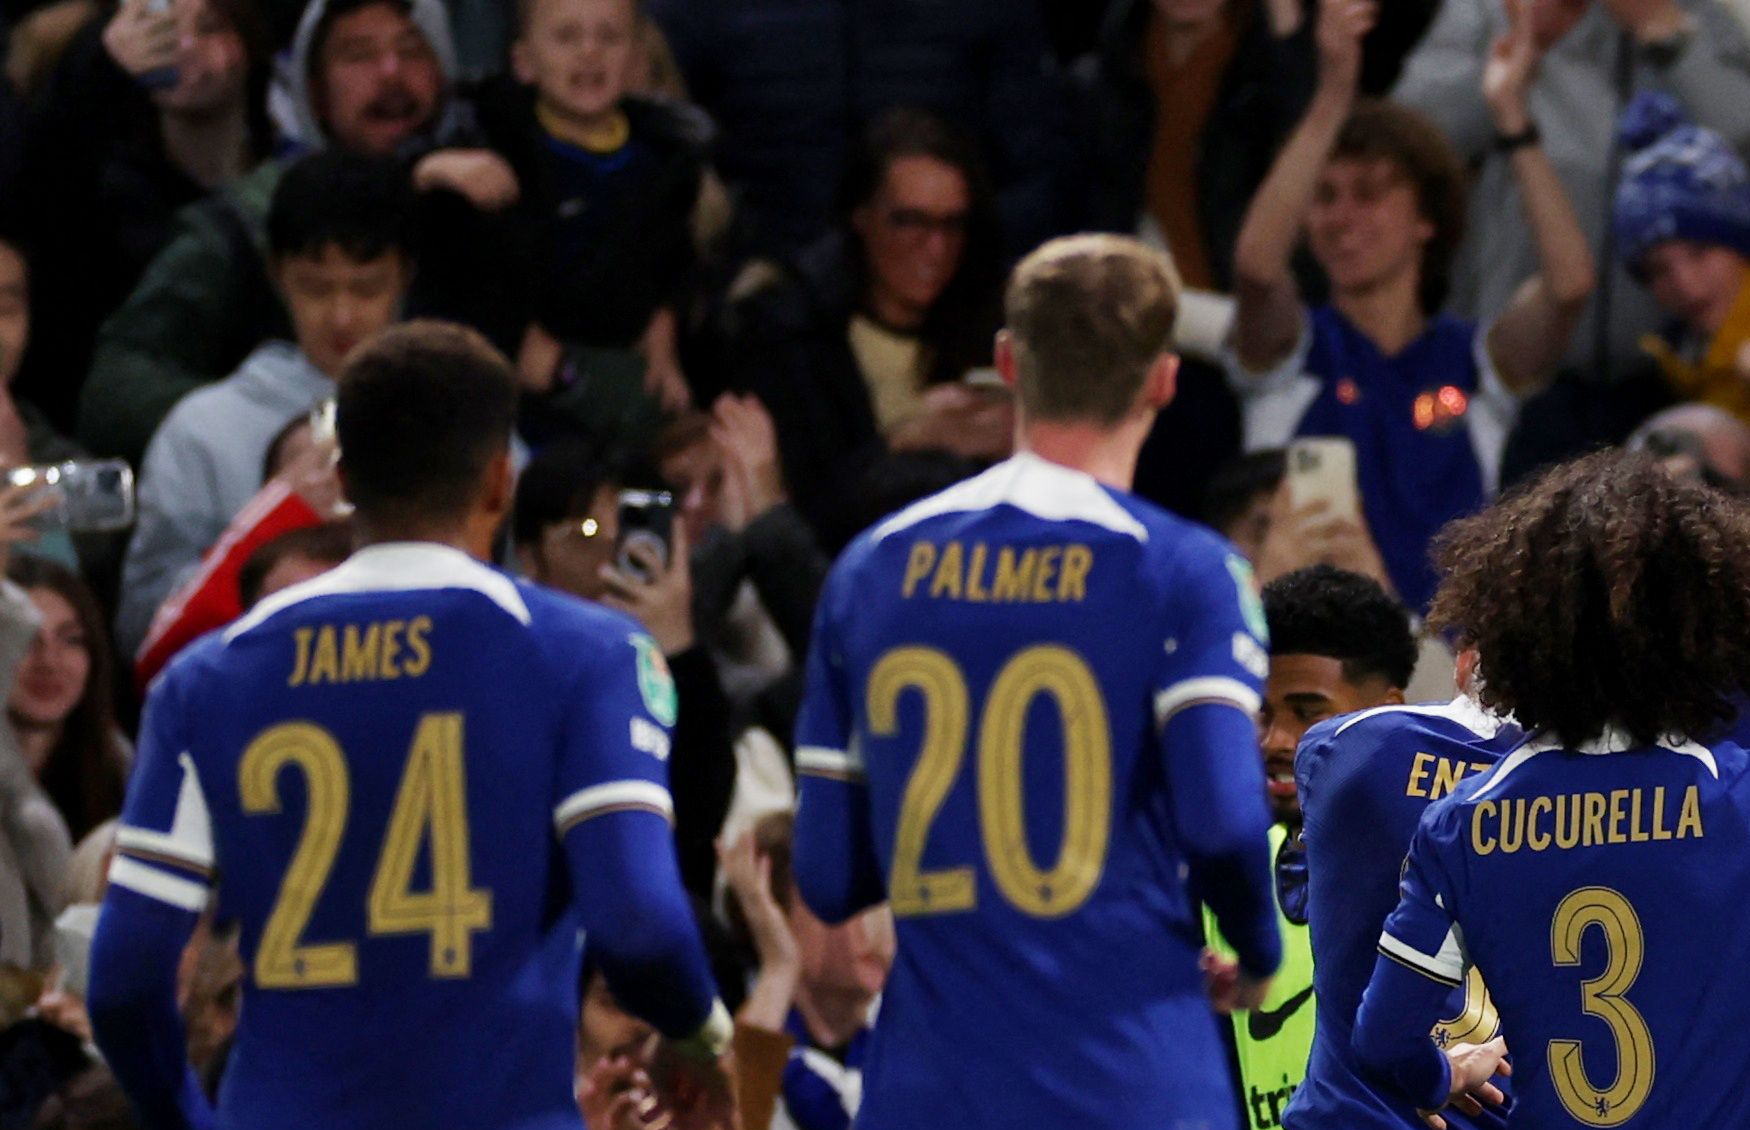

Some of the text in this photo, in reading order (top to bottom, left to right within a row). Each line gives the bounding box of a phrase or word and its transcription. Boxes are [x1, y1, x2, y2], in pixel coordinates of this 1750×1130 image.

[902, 542, 1095, 602] PALMER
[288, 616, 432, 687] JAMES
[237, 712, 492, 990] 24
[866, 644, 1114, 920] 20
[1471, 786, 1704, 856] CUCURELLA
[1547, 885, 1656, 1129] 3
